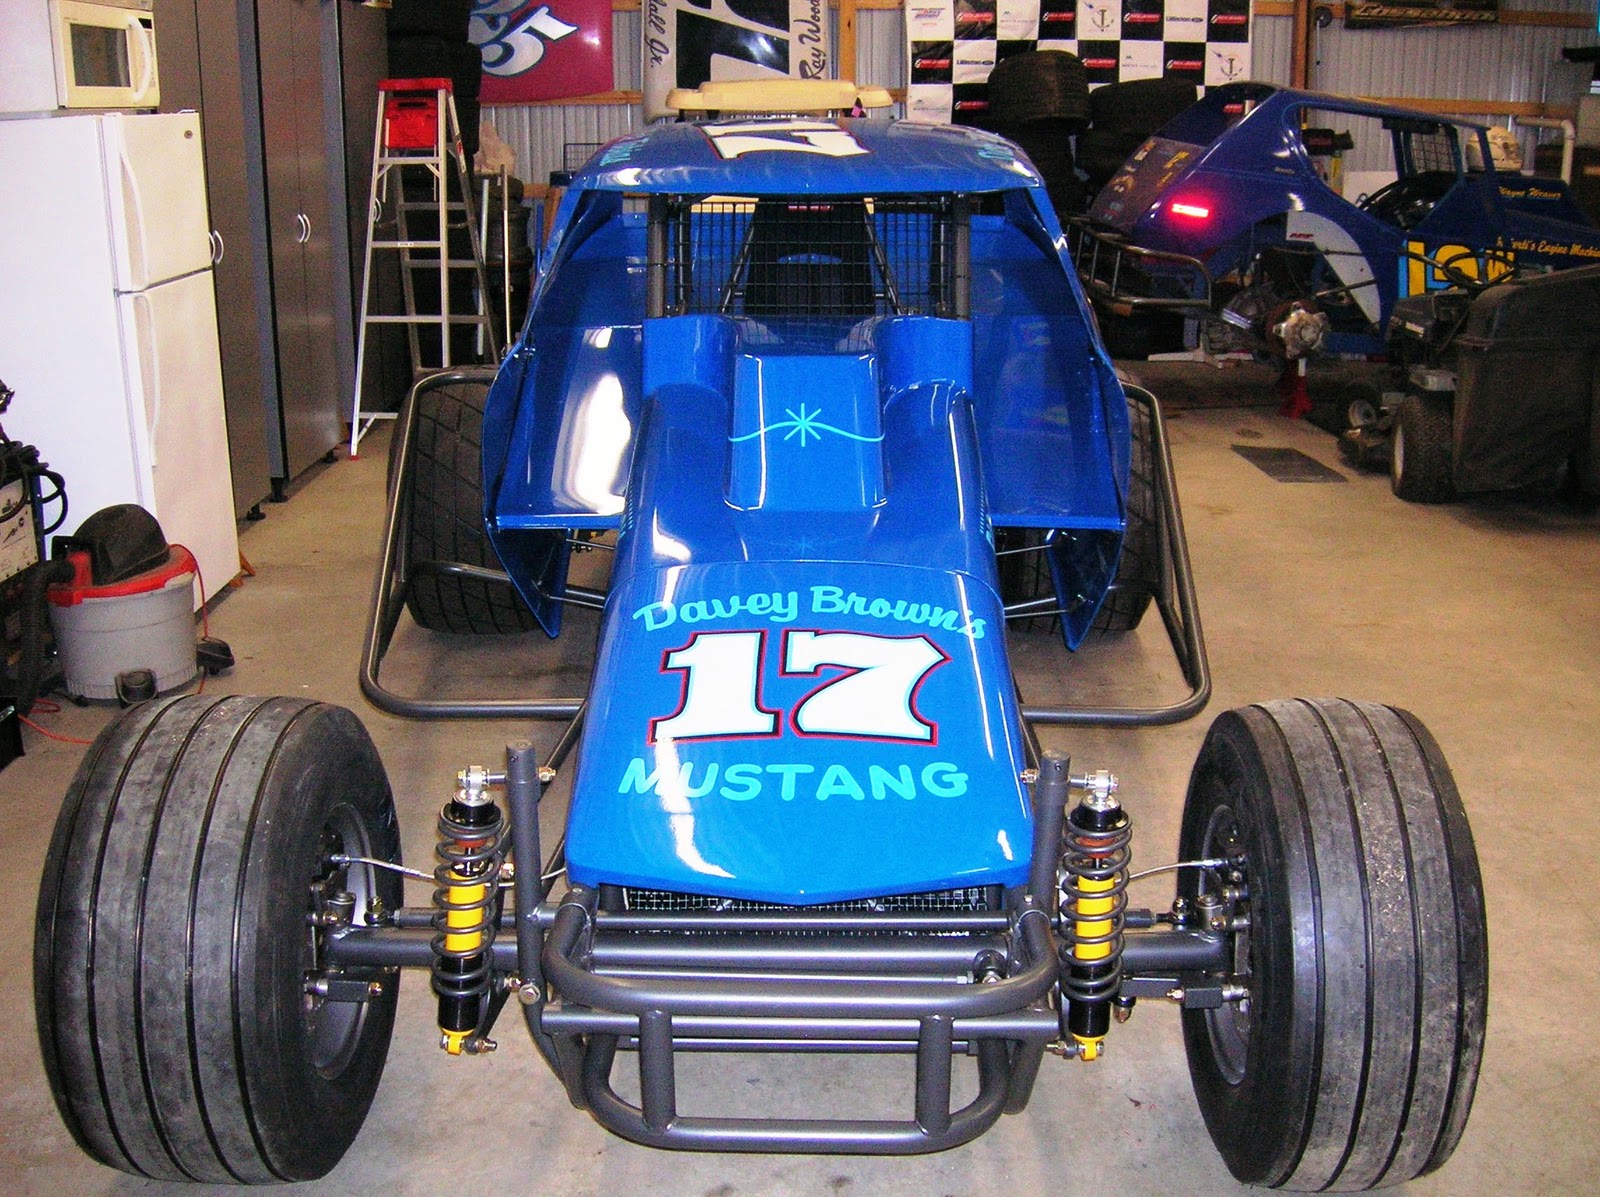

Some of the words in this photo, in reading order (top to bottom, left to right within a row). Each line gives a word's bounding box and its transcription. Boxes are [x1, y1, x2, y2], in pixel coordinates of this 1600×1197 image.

[799, 47, 826, 80] Ray
[632, 588, 798, 632] Davey
[810, 585, 986, 639] Brown's
[646, 629, 952, 745] 17
[618, 757, 969, 802] MUSTANG
